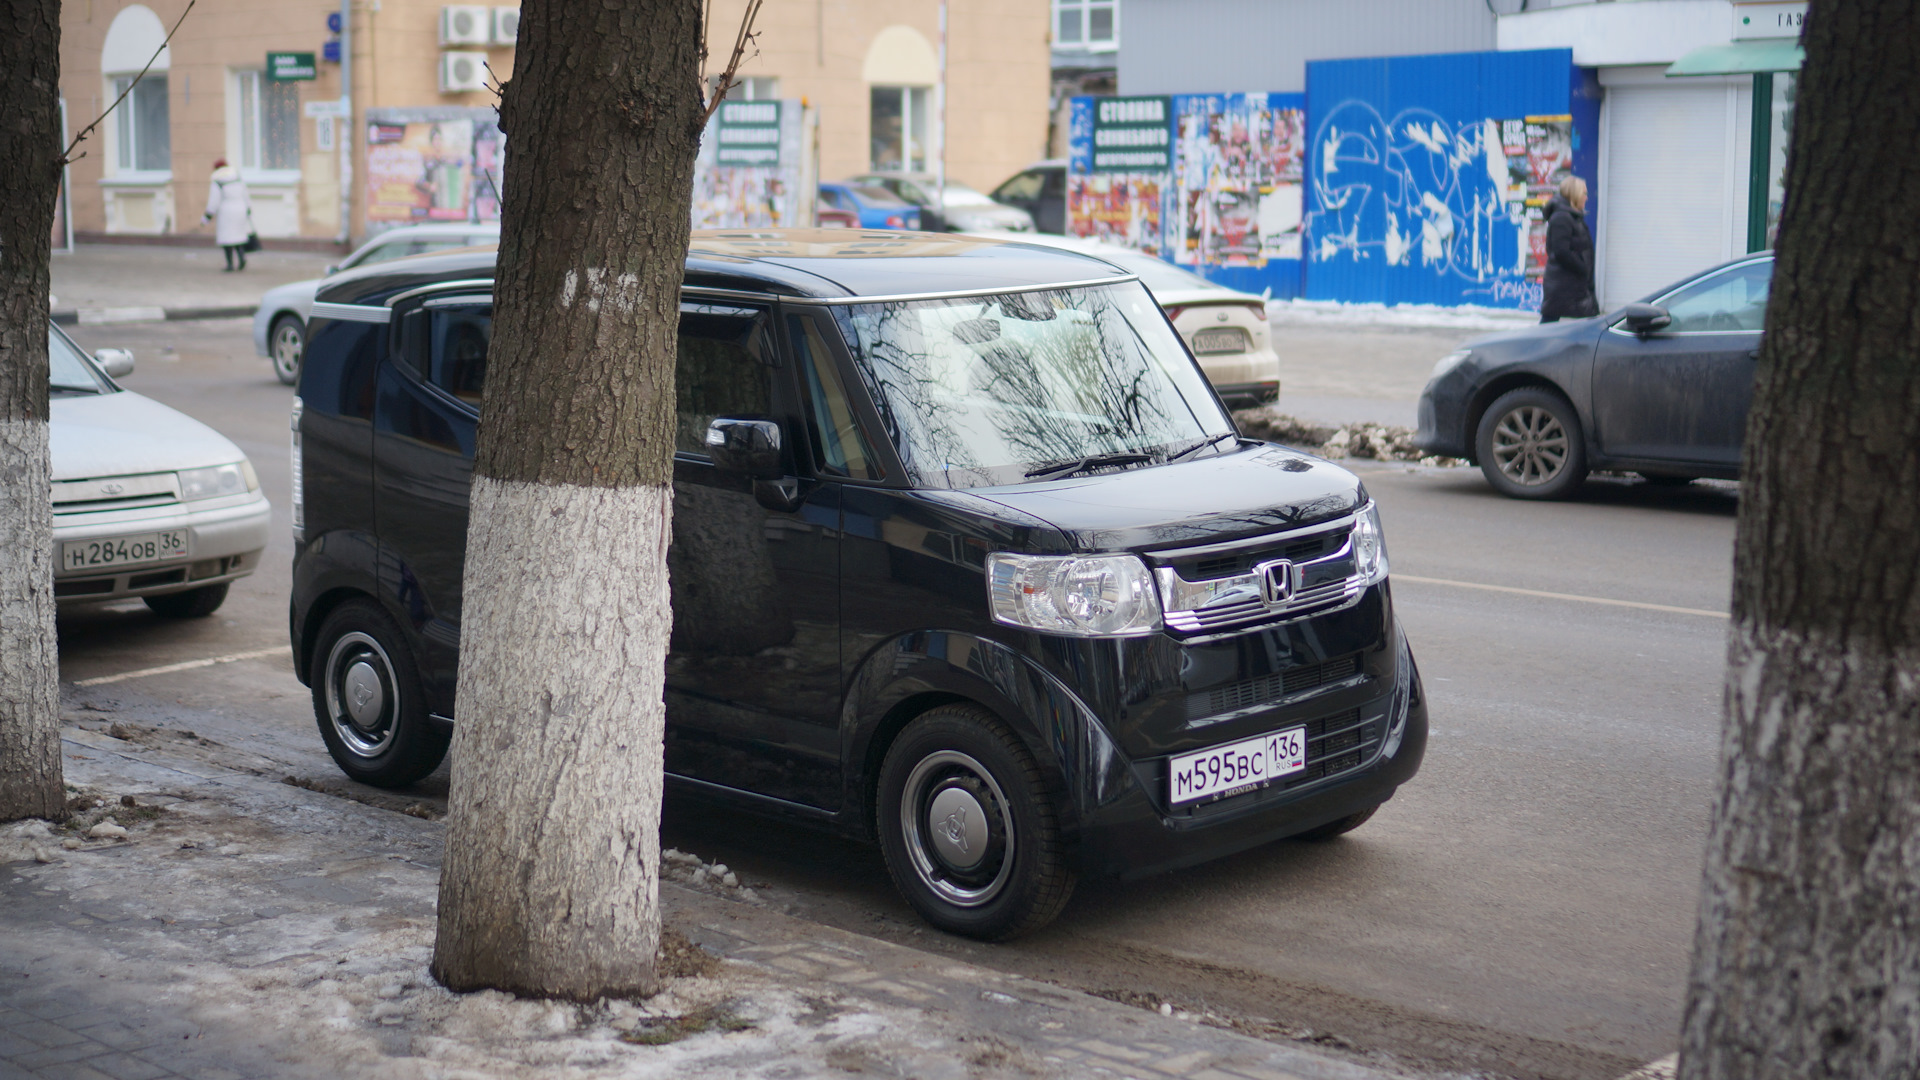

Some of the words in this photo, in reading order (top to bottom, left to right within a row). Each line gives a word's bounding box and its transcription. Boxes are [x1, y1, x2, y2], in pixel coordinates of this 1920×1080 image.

[1100, 101, 1164, 122] СТОЯНКА
[161, 532, 181, 549] 36
[1269, 733, 1299, 762] 136
[1275, 760, 1292, 771] RUS
[1224, 783, 1258, 797] HONDA
